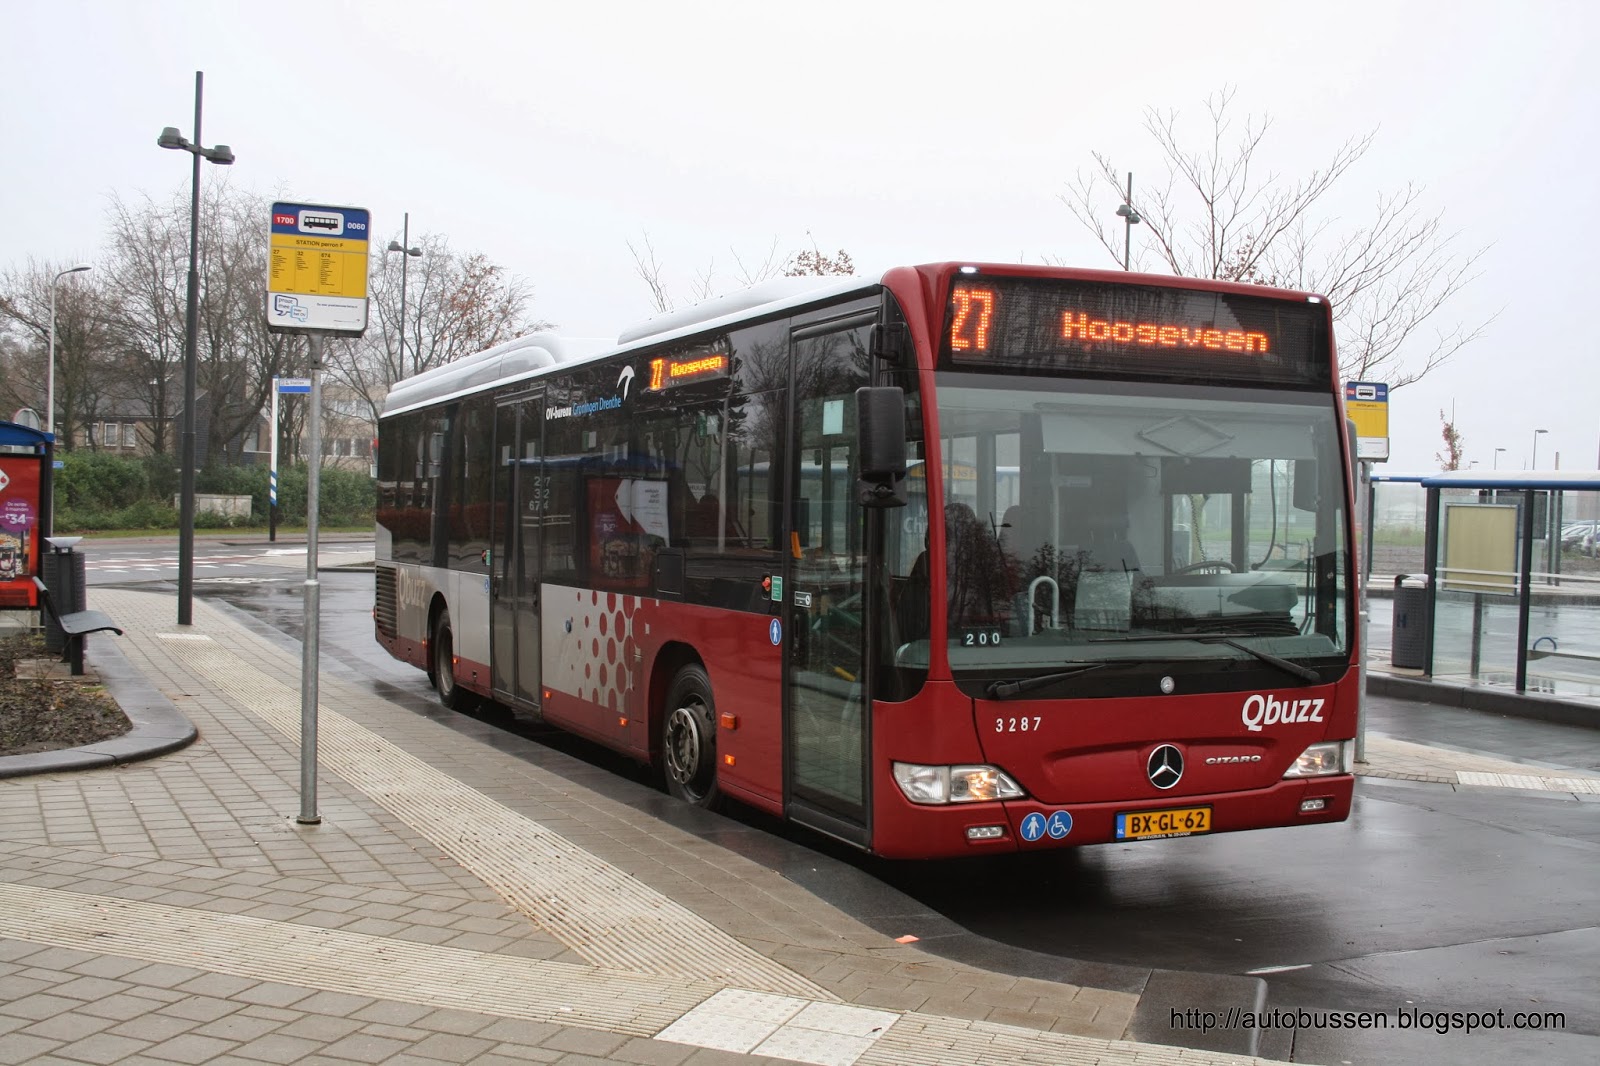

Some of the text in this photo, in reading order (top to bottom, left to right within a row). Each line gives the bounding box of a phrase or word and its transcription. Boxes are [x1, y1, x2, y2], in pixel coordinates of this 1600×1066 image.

[276, 216, 294, 225] 1700
[347, 222, 366, 231] 0060
[296, 239, 320, 247] STATION
[951, 289, 1269, 354] 27 Hoogeveen
[670, 356, 722, 377] Hoogeveen
[572, 399, 599, 416] Groningen
[599, 393, 622, 411] Drenthe
[534, 476, 551, 487] 27
[534, 488, 550, 499] 32
[529, 500, 549, 510] 674
[399, 567, 426, 611] Qbuzz
[965, 632, 1001, 646] 200
[1241, 694, 1325, 731] Qbuzz
[995, 716, 1042, 732] 3287
[1205, 754, 1262, 765] CITARO
[1131, 811, 1205, 833] BX-GL-62
